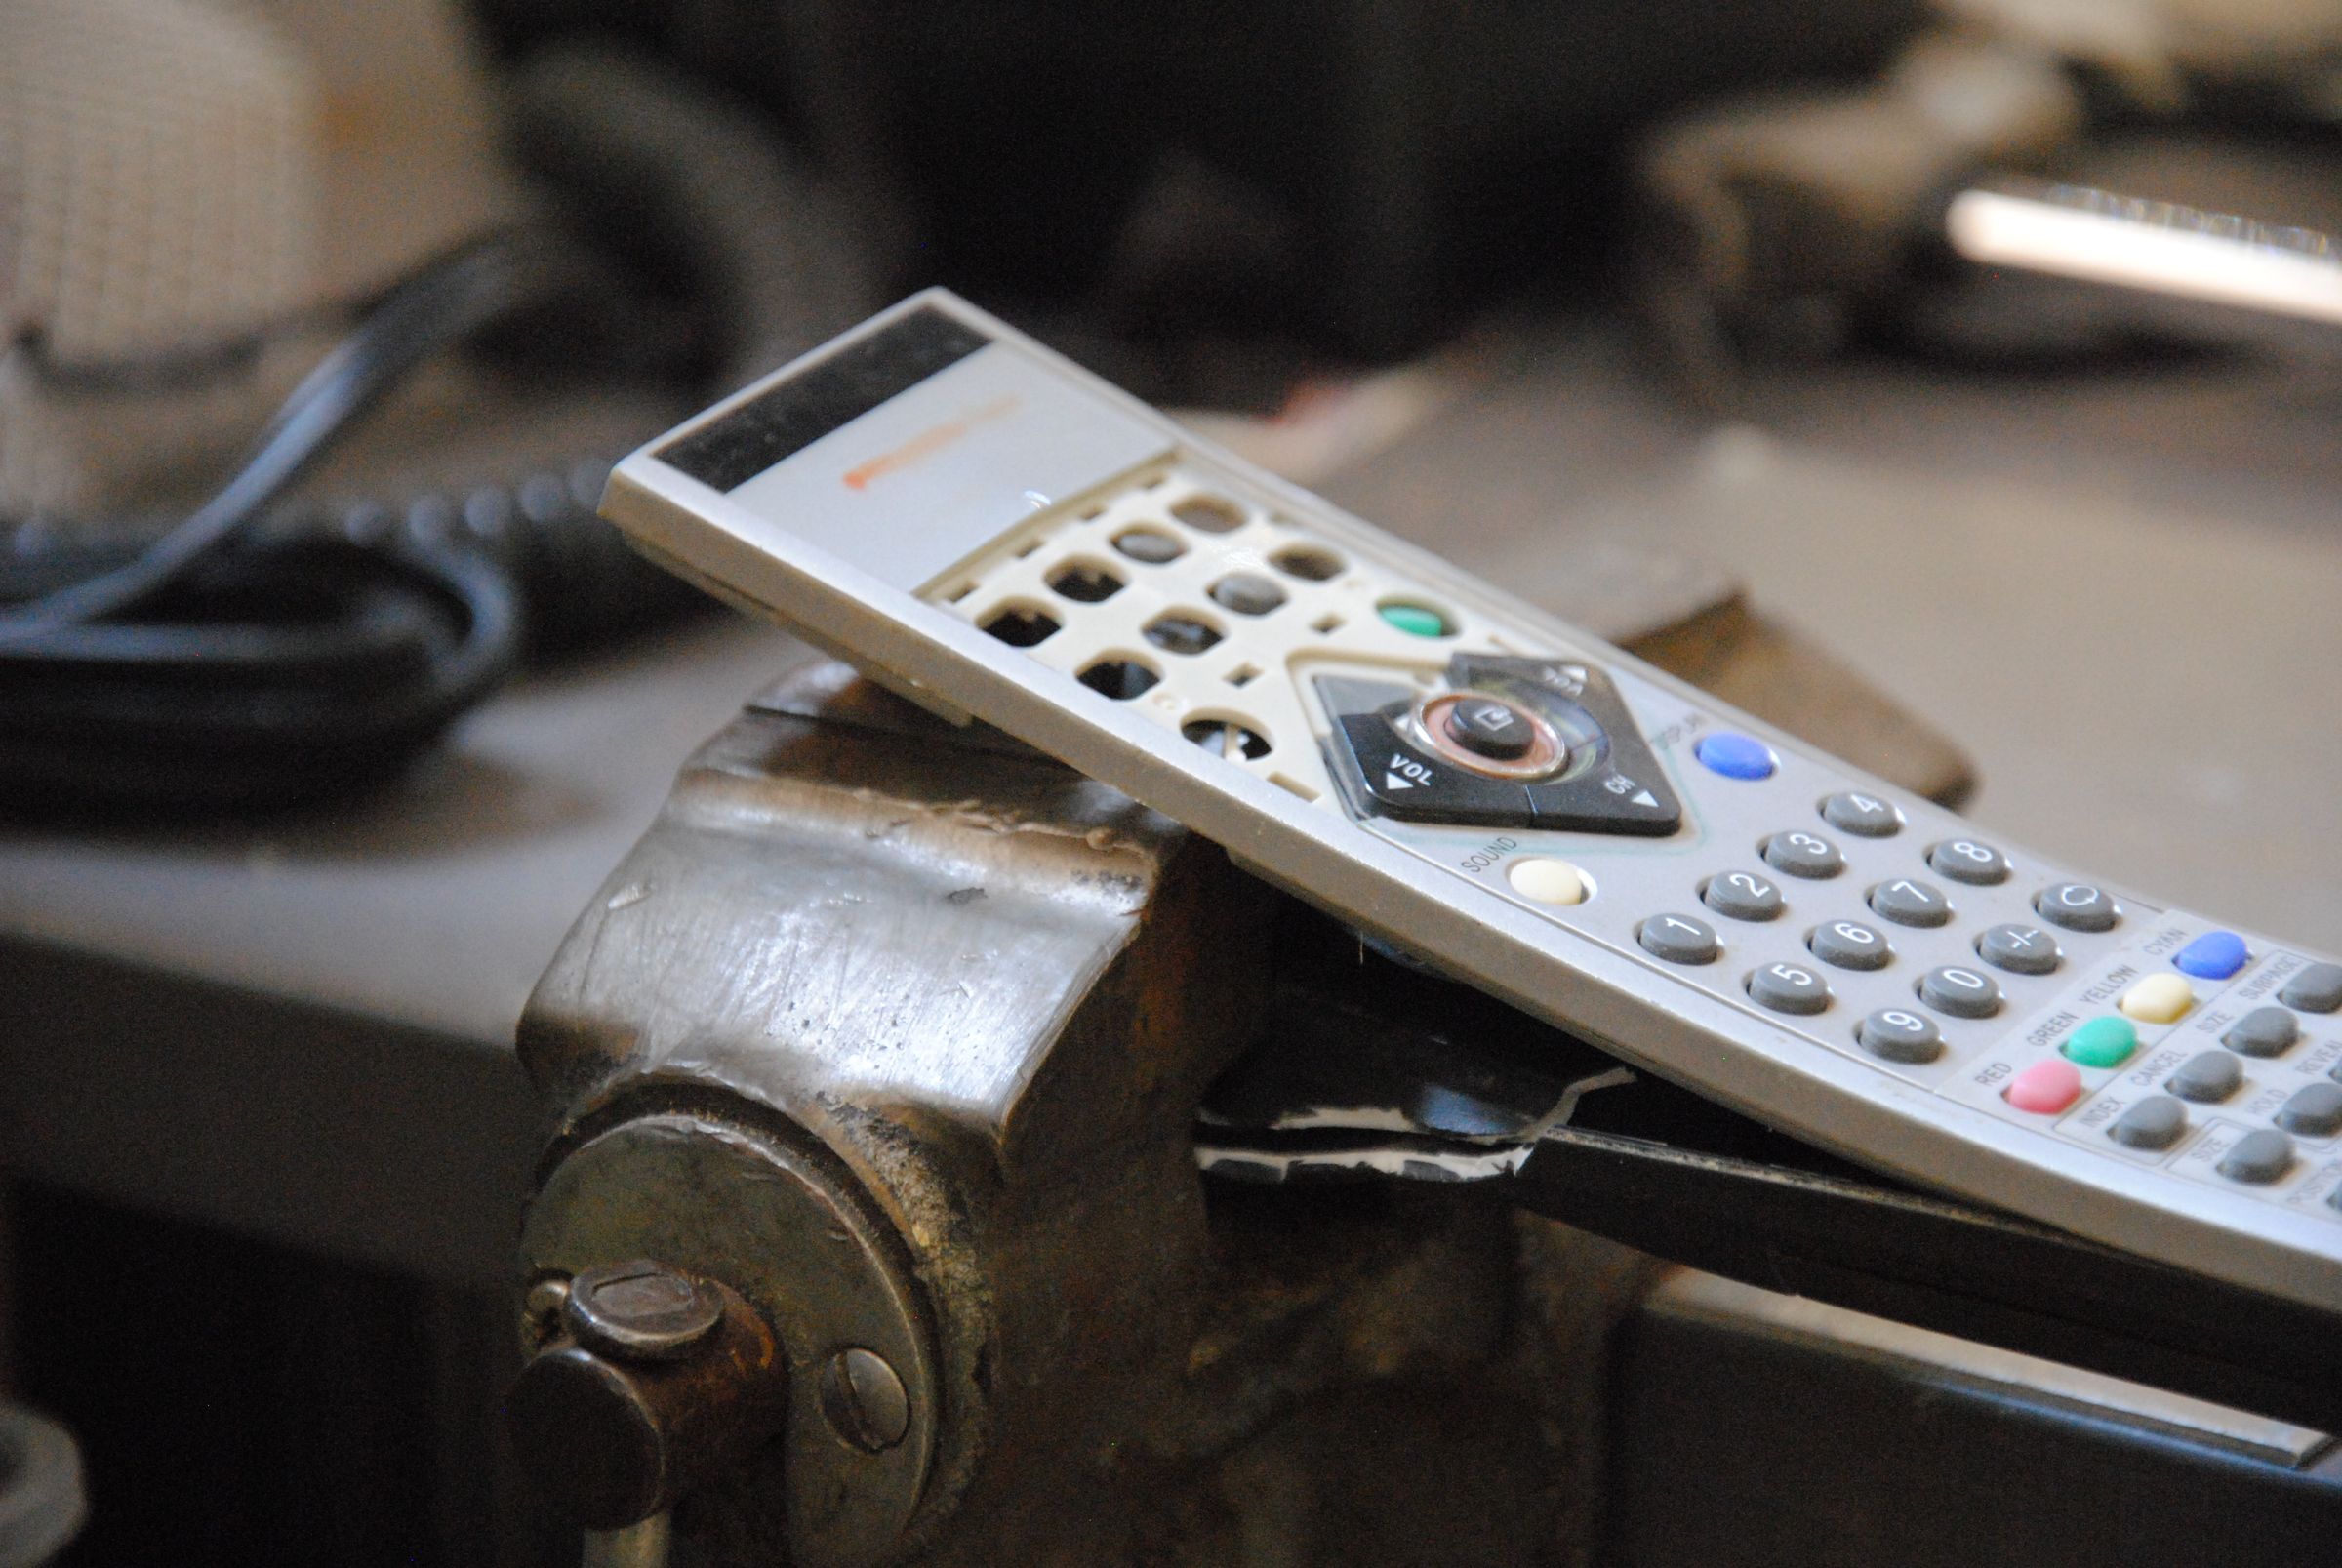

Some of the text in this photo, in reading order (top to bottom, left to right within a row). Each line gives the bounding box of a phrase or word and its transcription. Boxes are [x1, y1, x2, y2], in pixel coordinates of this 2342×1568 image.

[1390, 753, 1433, 786] VOL
[1605, 774, 1636, 795] CH
[1849, 793, 1884, 815] 4
[1461, 836, 1517, 873] SOUND
[1789, 833, 1828, 856] 3
[1952, 841, 1993, 863] 8
[1729, 873, 1770, 898] 2
[1891, 880, 1929, 903] 7
[1665, 916, 1702, 937] 1
[1833, 922, 1875, 945] 6
[2143, 927, 2189, 957] CYAN
[1770, 963, 1813, 986] 5
[1943, 968, 1984, 989] 0
[2079, 964, 2139, 1005] YELLOW
[1882, 1010, 1924, 1032] 9
[2026, 1011, 2080, 1047] GREEN
[2196, 1008, 2237, 1034] SIZE
[1974, 1063, 2013, 1087] RED
[2130, 1049, 2189, 1087] CANCEL
[2080, 1095, 2127, 1127] INDEX
